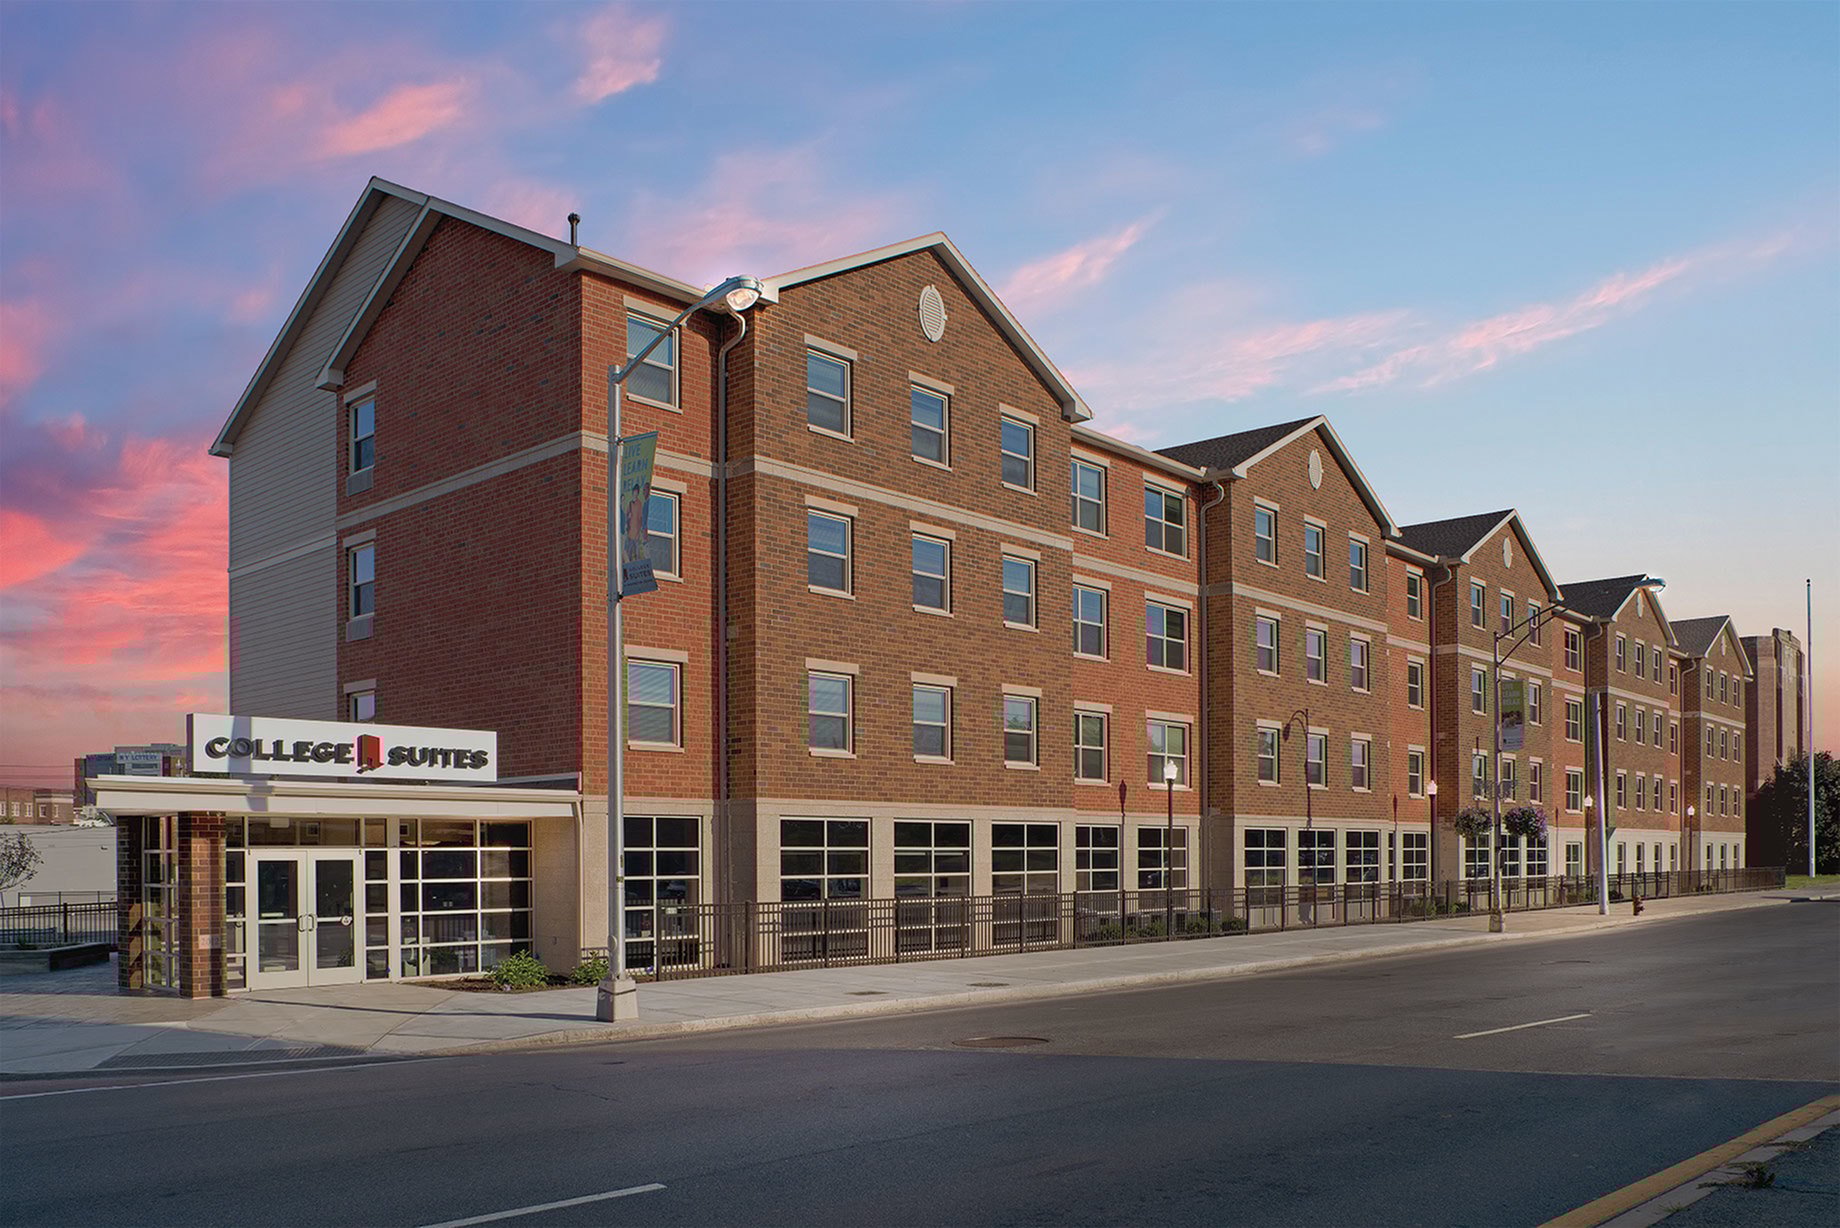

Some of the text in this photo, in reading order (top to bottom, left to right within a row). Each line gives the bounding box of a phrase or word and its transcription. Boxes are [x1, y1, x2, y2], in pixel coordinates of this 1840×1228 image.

[623, 443, 641, 461] LIVE
[623, 459, 649, 475] LEARN
[204, 736, 489, 770] COLLEGE SUITES
